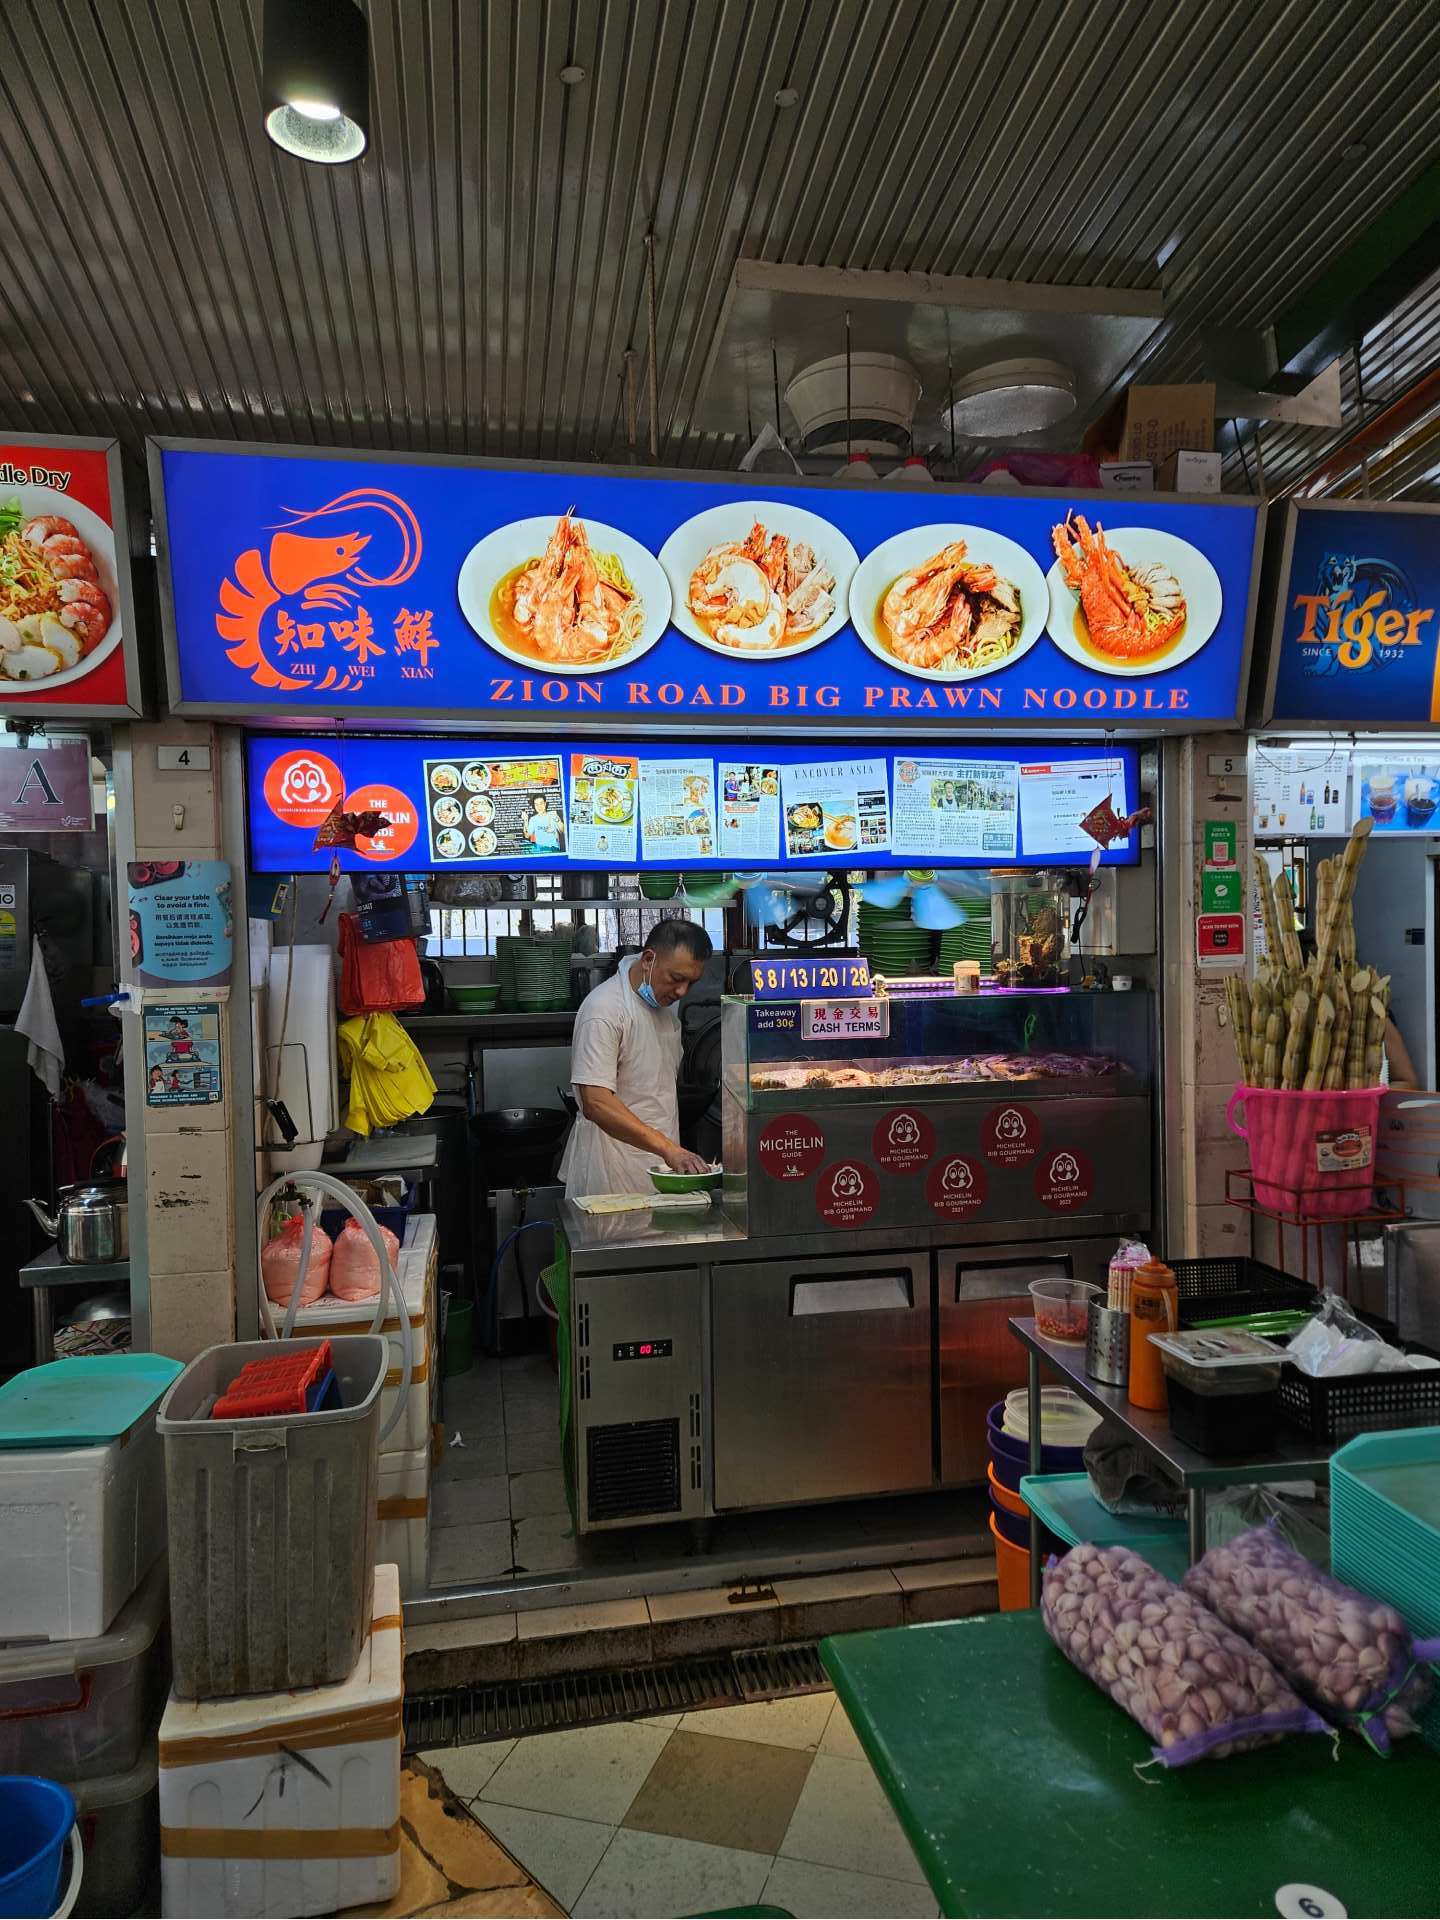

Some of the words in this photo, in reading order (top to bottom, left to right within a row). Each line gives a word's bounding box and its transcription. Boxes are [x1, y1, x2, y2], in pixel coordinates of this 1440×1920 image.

[30, 466, 71, 491] Dry
[275, 605, 440, 667] 知味鮮
[1294, 589, 1435, 669] Tiger
[1302, 648, 1332, 657] SINCE
[1380, 649, 1404, 658] 1932
[290, 663, 316, 675] ZHI
[348, 665, 375, 677] WEI
[401, 667, 434, 679] XIAN
[489, 679, 604, 703] ZION
[627, 682, 746, 705] ROAD
[769, 685, 842, 707] BIG
[863, 687, 1002, 708] PRAWN
[1023, 687, 1191, 709] NOODLE
[178, 750, 190, 765] 4
[1224, 759, 1233, 772] 5
[11, 758, 64, 804] A
[369, 800, 388, 808] THE
[755, 1009, 797, 1018] Takeaway
[814, 1006, 879, 1020] 現金交易
[758, 1021, 774, 1029] add
[776, 1018, 794, 1028] 30¢
[812, 1022, 841, 1033] CASH
[845, 1021, 881, 1032] TERMS
[760, 1136, 824, 1152] MICHELIN
